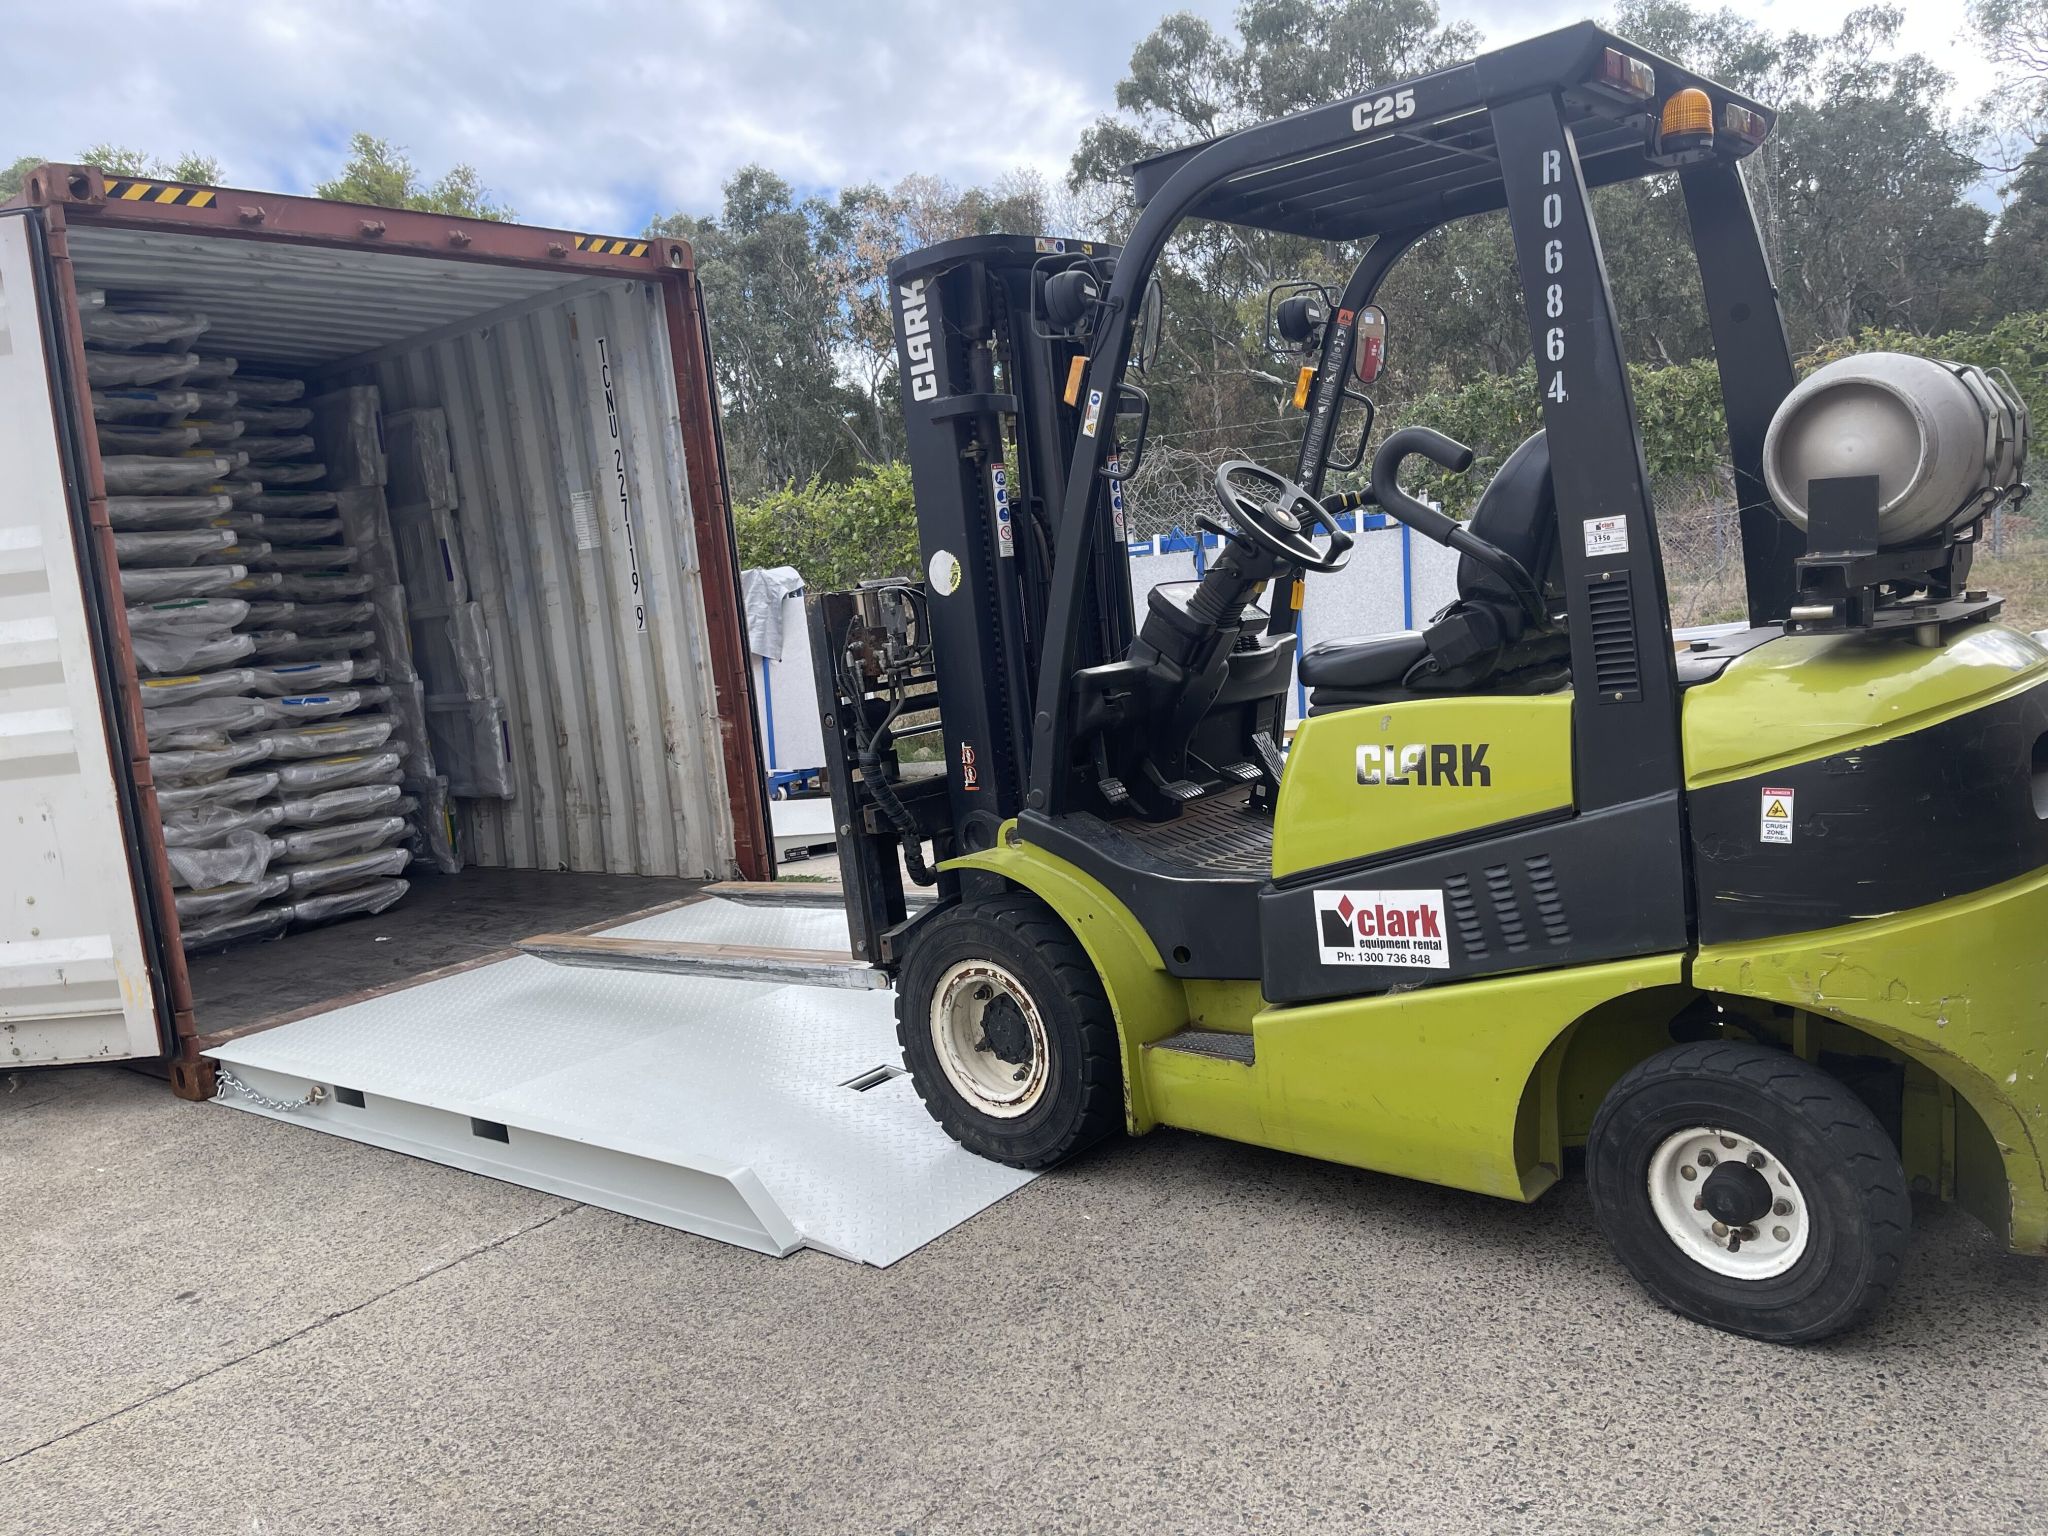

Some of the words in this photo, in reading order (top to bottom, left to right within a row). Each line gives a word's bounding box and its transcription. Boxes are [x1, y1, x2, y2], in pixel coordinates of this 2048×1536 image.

[1352, 89, 1416, 132] C25
[1542, 150, 1567, 403] R068864
[900, 279, 938, 402] CLARK
[598, 339, 618, 438] TCNU
[614, 449, 639, 594] 227119
[635, 605, 644, 629] 9
[1356, 744, 1491, 786] CLARK
[1357, 905, 1441, 937] clark
[1337, 951, 1355, 962] Ph:
[1358, 952, 1384, 962] 1300
[1388, 953, 1407, 964] 736
[1410, 954, 1431, 964] 848
[1359, 938, 1410, 950] equipment
[1413, 939, 1442, 951] rental
